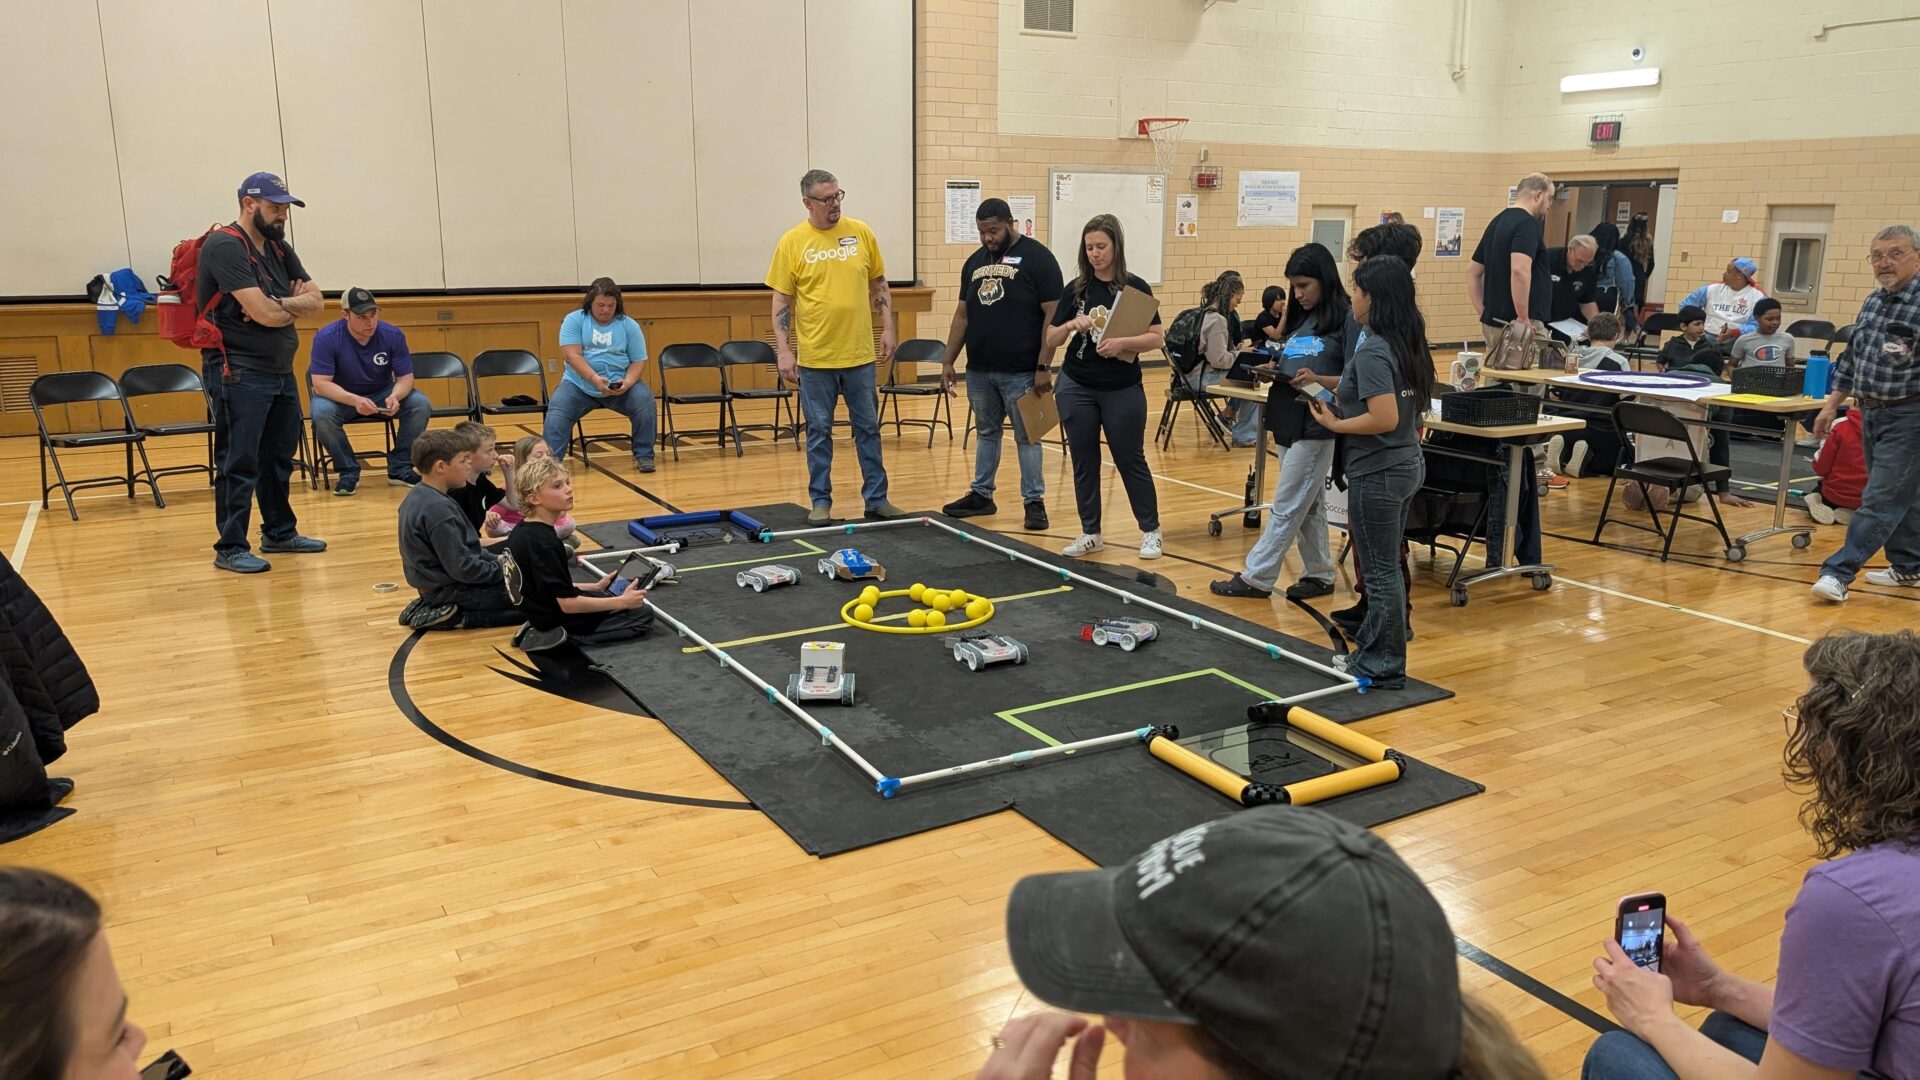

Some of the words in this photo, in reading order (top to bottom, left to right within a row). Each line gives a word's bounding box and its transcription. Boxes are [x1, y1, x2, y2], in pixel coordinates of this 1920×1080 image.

[1596, 123, 1616, 140] EXIT
[803, 245, 858, 264] Google
[972, 264, 1019, 282] KENNEDY
[1713, 303, 1730, 312] THE
[1731, 305, 1748, 316] LOU
[1325, 502, 1349, 515] Soccer
